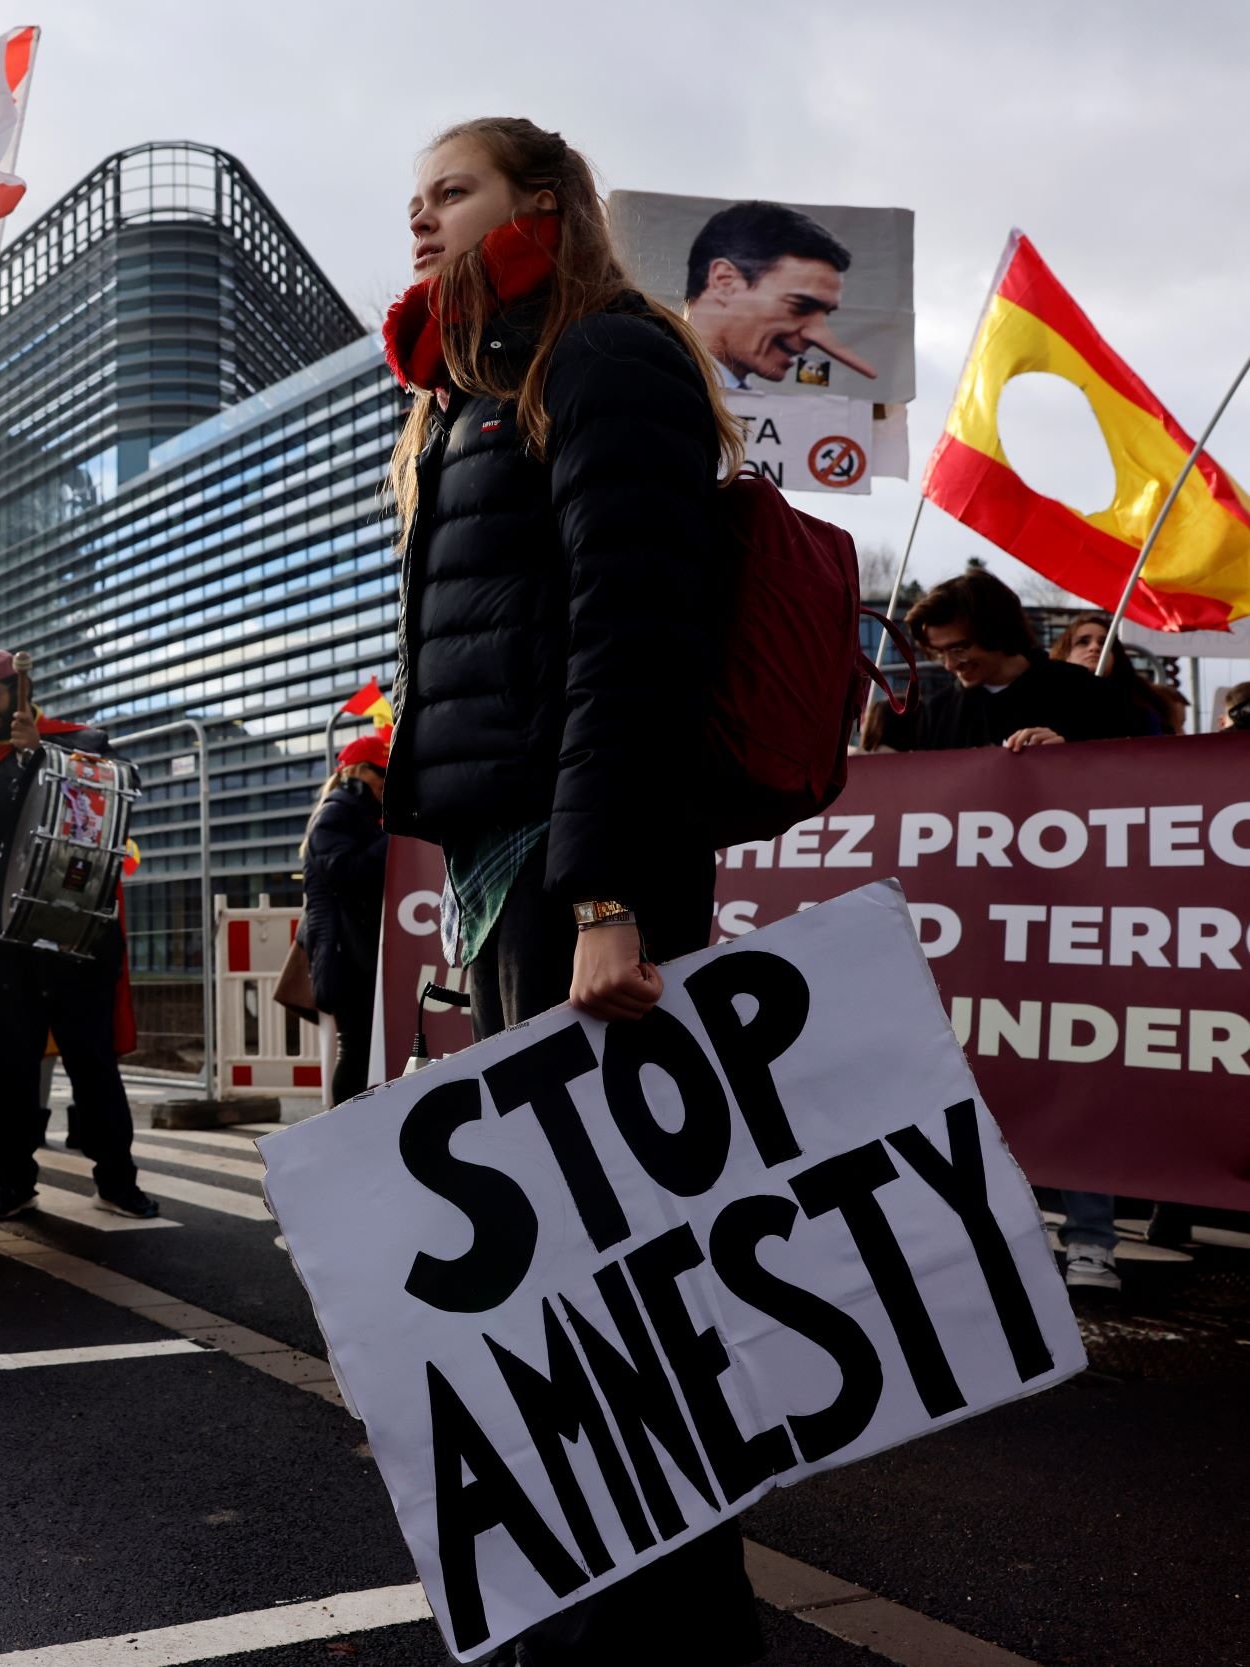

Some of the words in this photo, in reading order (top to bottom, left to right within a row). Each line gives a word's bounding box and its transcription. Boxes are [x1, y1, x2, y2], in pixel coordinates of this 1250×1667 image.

[988, 904, 1250, 970] TERR
[398, 950, 810, 1314] STOP
[425, 1097, 1055, 1654] AMNESTY
